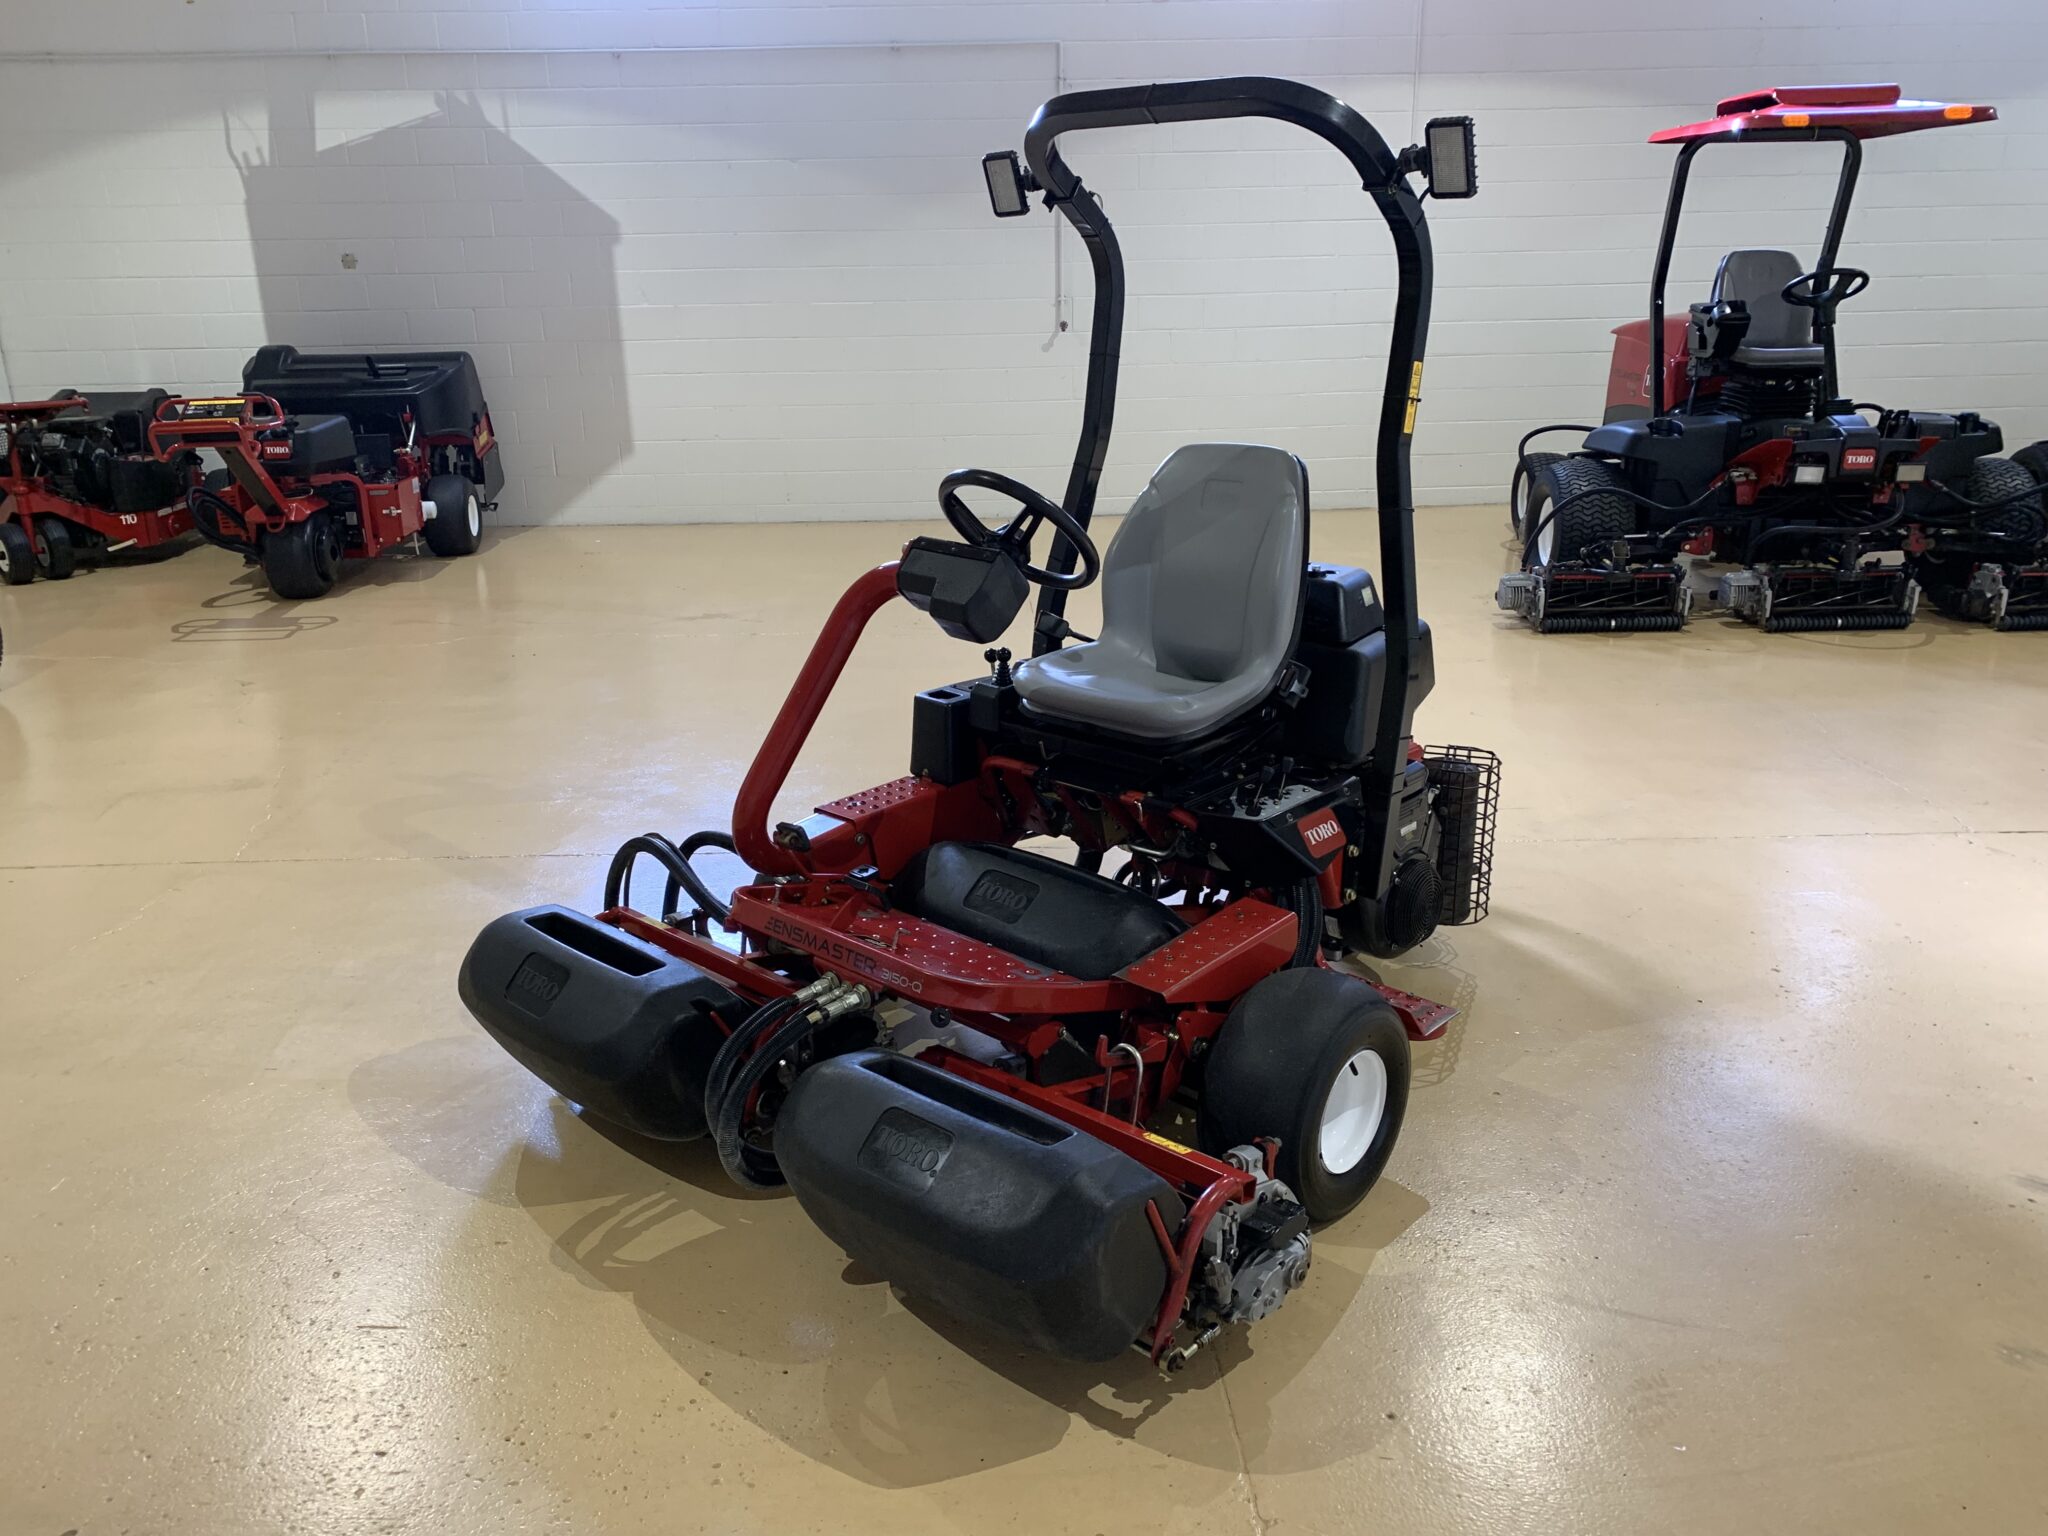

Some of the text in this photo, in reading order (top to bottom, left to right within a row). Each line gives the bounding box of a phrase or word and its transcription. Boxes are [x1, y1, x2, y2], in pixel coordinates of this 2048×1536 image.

[265, 446, 289, 454] TORO
[1847, 455, 1874, 464] TORO
[120, 514, 137, 525] 110
[1304, 819, 1338, 846] TORO
[976, 881, 1028, 911] TORO
[881, 967, 923, 994] 3150-Q
[872, 1126, 940, 1173] TORO
